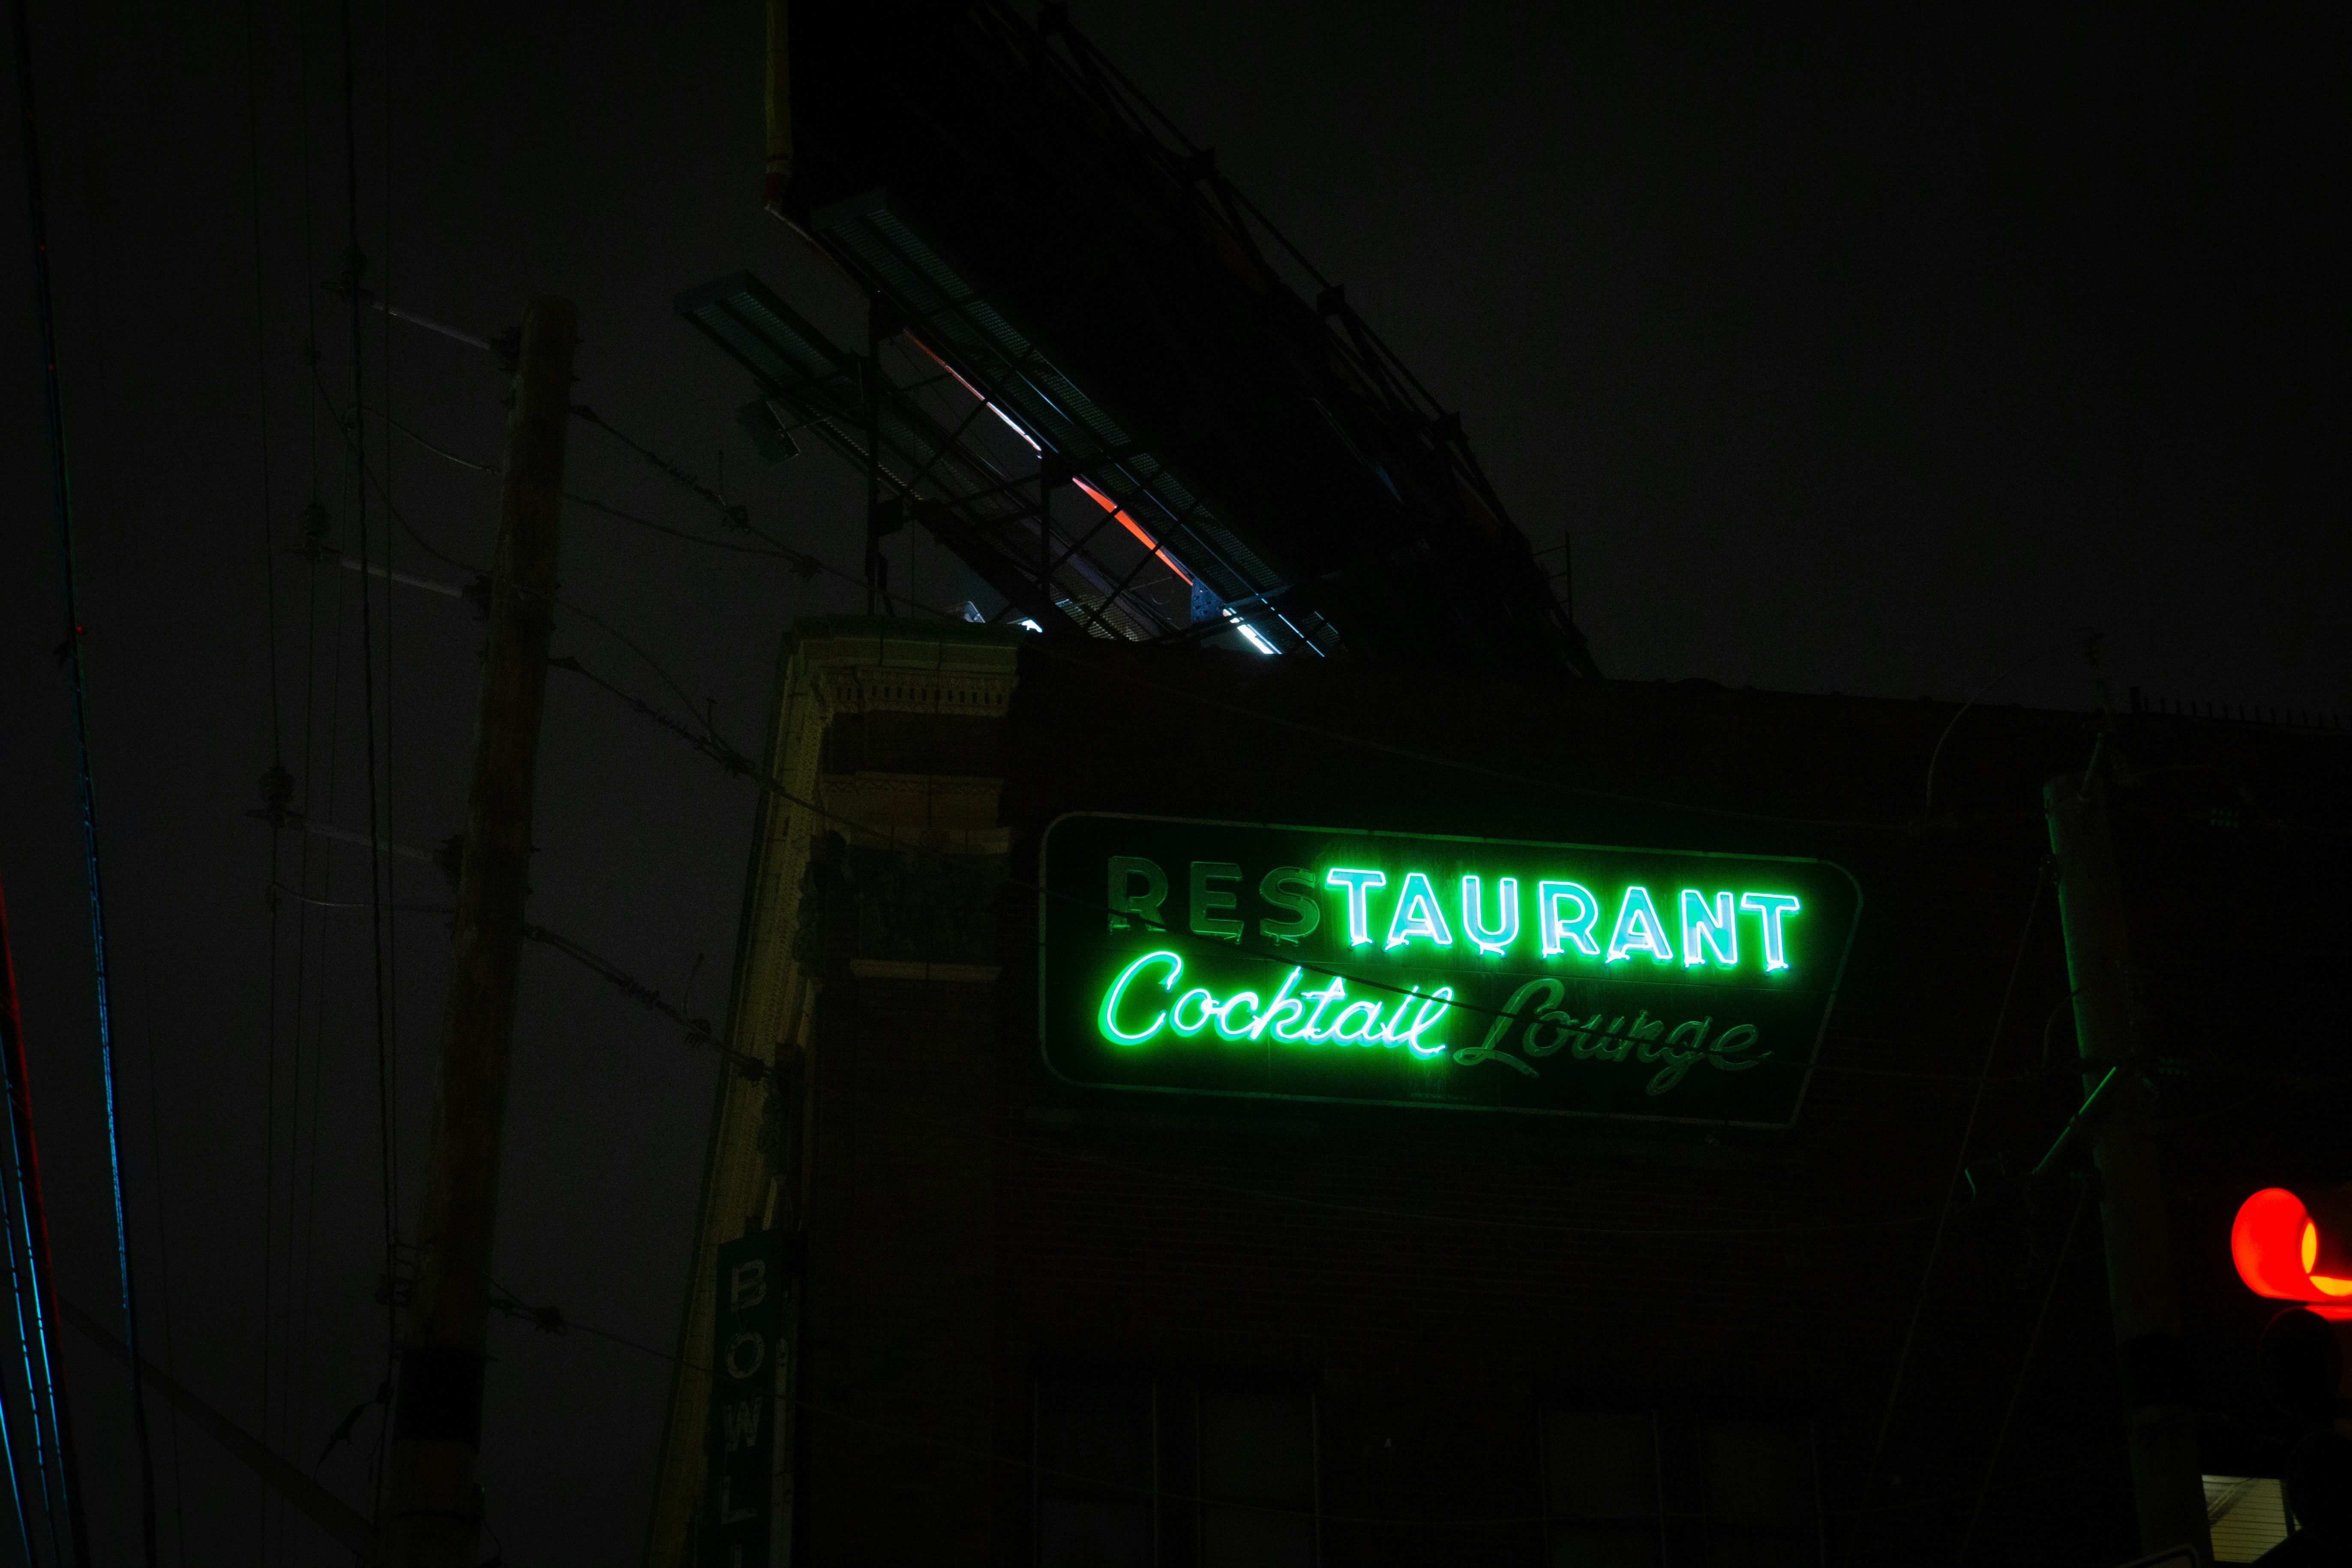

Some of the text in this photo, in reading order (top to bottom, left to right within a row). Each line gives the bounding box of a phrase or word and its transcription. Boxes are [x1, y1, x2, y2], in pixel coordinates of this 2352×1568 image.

[1108, 856, 1800, 971] RESTAURANT
[1097, 950, 1775, 1096] Cocktail Lounge
